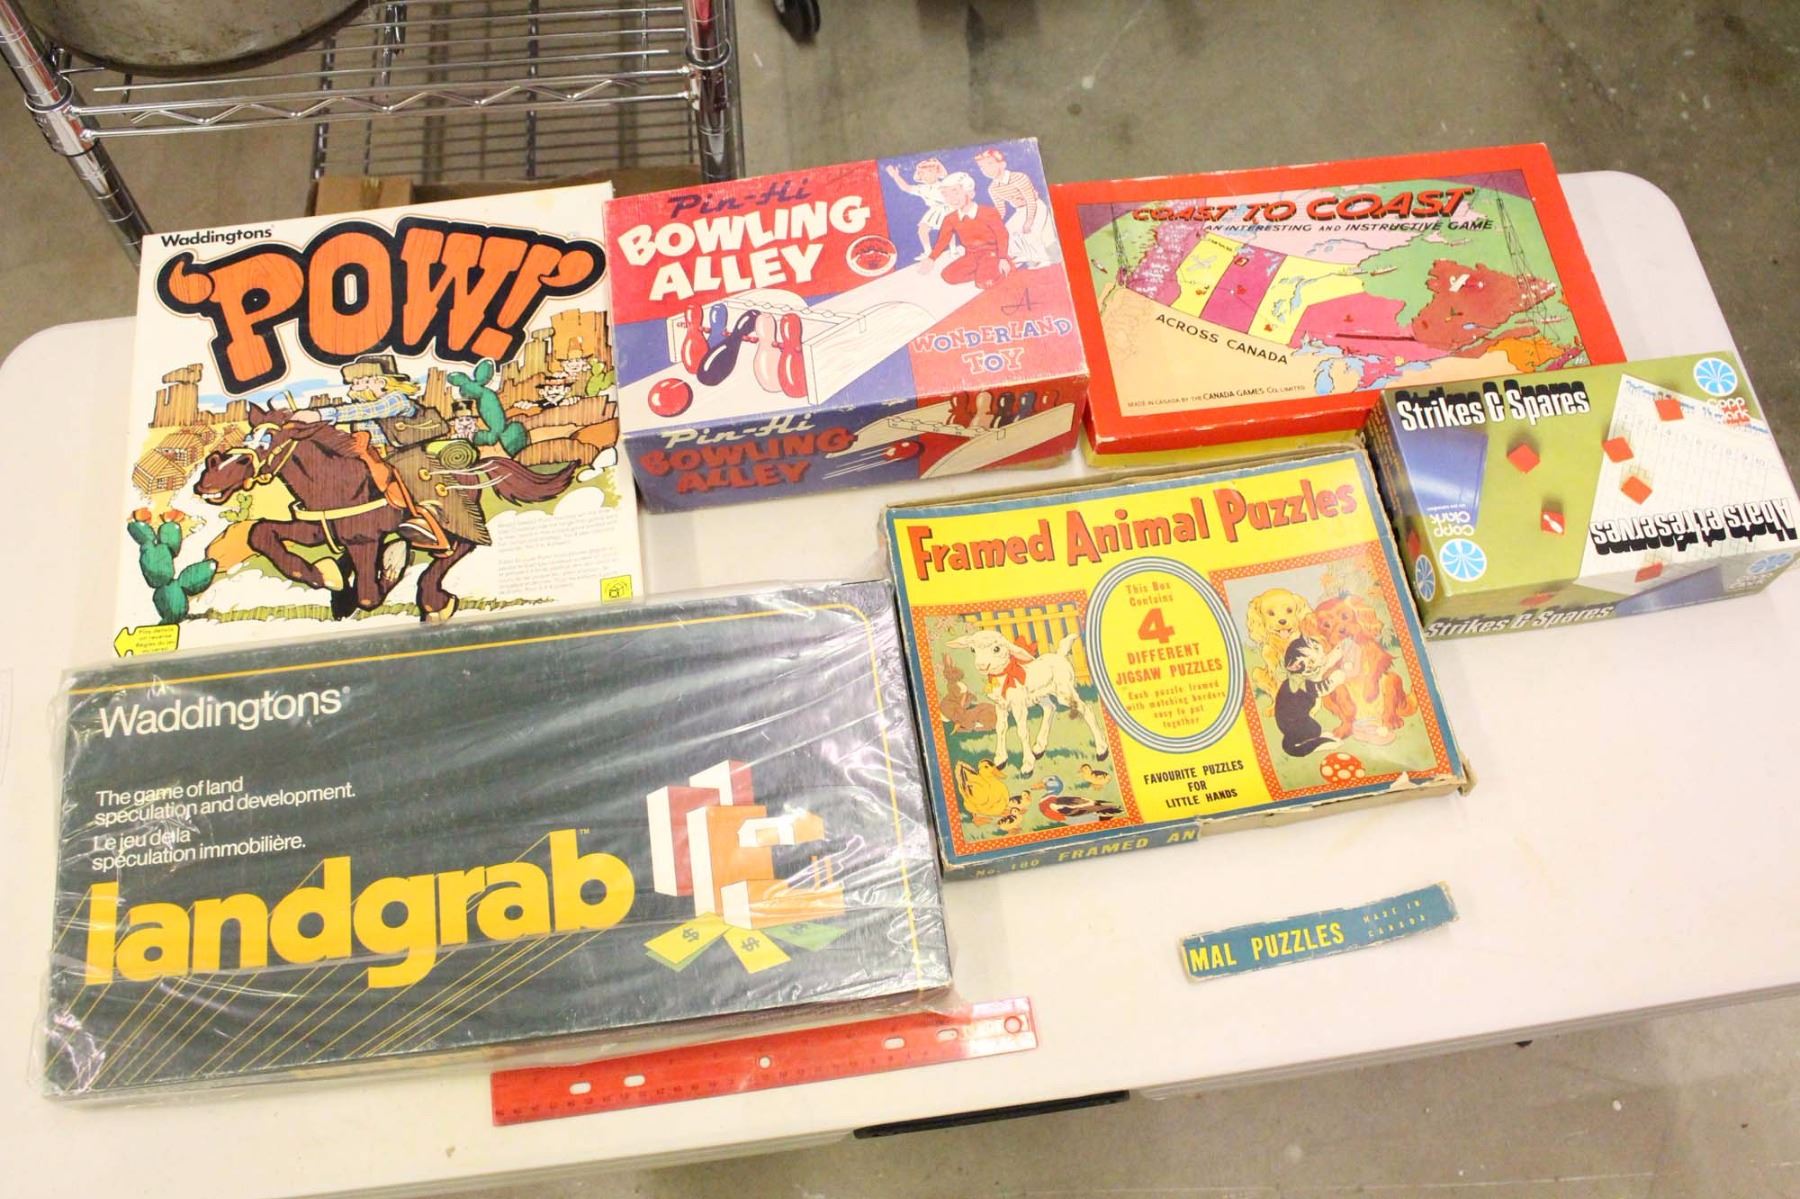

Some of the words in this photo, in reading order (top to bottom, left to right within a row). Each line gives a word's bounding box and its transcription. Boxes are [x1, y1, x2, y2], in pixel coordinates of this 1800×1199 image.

[668, 178, 813, 218] Pin-Hi
[1132, 205, 1237, 222] COAST
[1243, 200, 1298, 224] TO
[1306, 187, 1475, 221] COAST
[161, 229, 272, 248] Waddingtons
[617, 195, 870, 266] BOWLING
[1205, 224, 1219, 232] AN
[1225, 223, 1312, 232] INTERESTING
[1319, 224, 1342, 232] AND
[1345, 222, 1443, 232] INSTRUCTIVE
[1447, 219, 1494, 231] GAME
[649, 243, 823, 302] ALLEY
[912, 315, 1072, 353] WONDERLAND
[1156, 313, 1219, 344] ACROSS
[1226, 339, 1288, 365] CANADA
[961, 347, 1025, 375] TOY
[1203, 390, 1235, 401] CANADA
[1236, 387, 1265, 398] GAMES
[1395, 394, 1486, 432] Strikes
[1484, 389, 1505, 423] &
[1505, 387, 1590, 425] Spares
[659, 413, 816, 449] Pin-Hi
[640, 426, 857, 477] BOWLING
[676, 460, 811, 494] ALLEY
[907, 519, 1054, 580] Framed
[1066, 497, 1209, 566] Animal
[1213, 479, 1358, 543] Puzzles
[1698, 508, 1724, 536] et
[1723, 498, 1794, 534] Abats
[1125, 583, 1149, 595] This
[1152, 581, 1172, 591] Box
[1129, 594, 1174, 607] Contains
[1138, 608, 1176, 644] 4
[1426, 616, 1510, 637] Strikes
[1532, 605, 1614, 629] Spares
[1127, 643, 1200, 665] DIFFERENT
[1115, 667, 1161, 686] JIGSAW
[1169, 658, 1223, 677] PUZZLES
[1126, 702, 1145, 712] with
[1150, 695, 1188, 709] matching
[1192, 690, 1226, 702] borders
[1128, 690, 1149, 701] Each
[1155, 685, 1183, 698] puzzle
[1189, 679, 1219, 691] framed
[100, 688, 342, 738] Waddingtons
[1163, 717, 1199, 729] together
[1144, 767, 1196, 785] FAVOURITE
[1203, 760, 1244, 777] PUZZLES
[1188, 780, 1207, 793] FOR
[94, 799, 198, 828] speculation
[201, 795, 234, 815] and
[237, 782, 356, 811] development.
[96, 789, 131, 808] The
[133, 786, 184, 806] game
[186, 780, 205, 798] of
[206, 776, 243, 793] land
[1166, 796, 1200, 809] LITTLE
[1206, 788, 1238, 802] HANDS
[94, 834, 117, 851] Le
[119, 832, 148, 855] jeu
[175, 827, 191, 844] la
[199, 833, 306, 860] immobilière.
[1058, 836, 1149, 862] FRAMED
[85, 829, 635, 989] landgrab
[1189, 943, 1237, 972] MAL
[1251, 922, 1345, 960] PUZZLES
